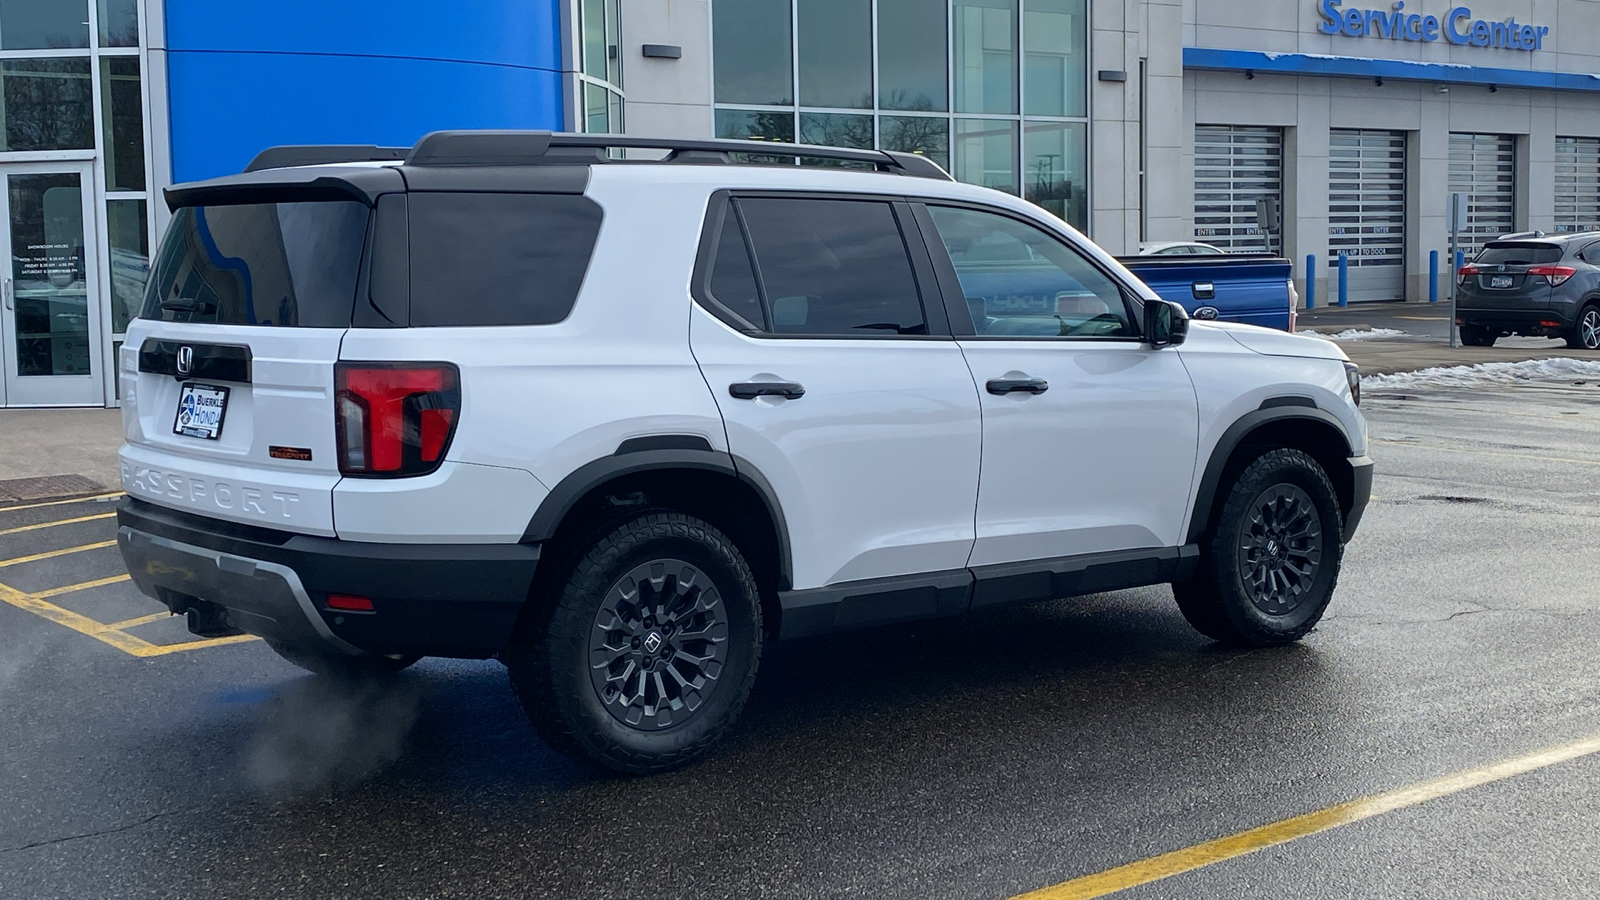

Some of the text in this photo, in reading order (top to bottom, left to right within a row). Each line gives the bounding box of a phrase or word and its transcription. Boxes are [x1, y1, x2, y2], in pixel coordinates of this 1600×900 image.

[1318, 0, 1549, 50] Service Center
[193, 406, 220, 425] HONDA
[196, 394, 224, 408] BUERKLE
[121, 460, 299, 517] PASSPORT
